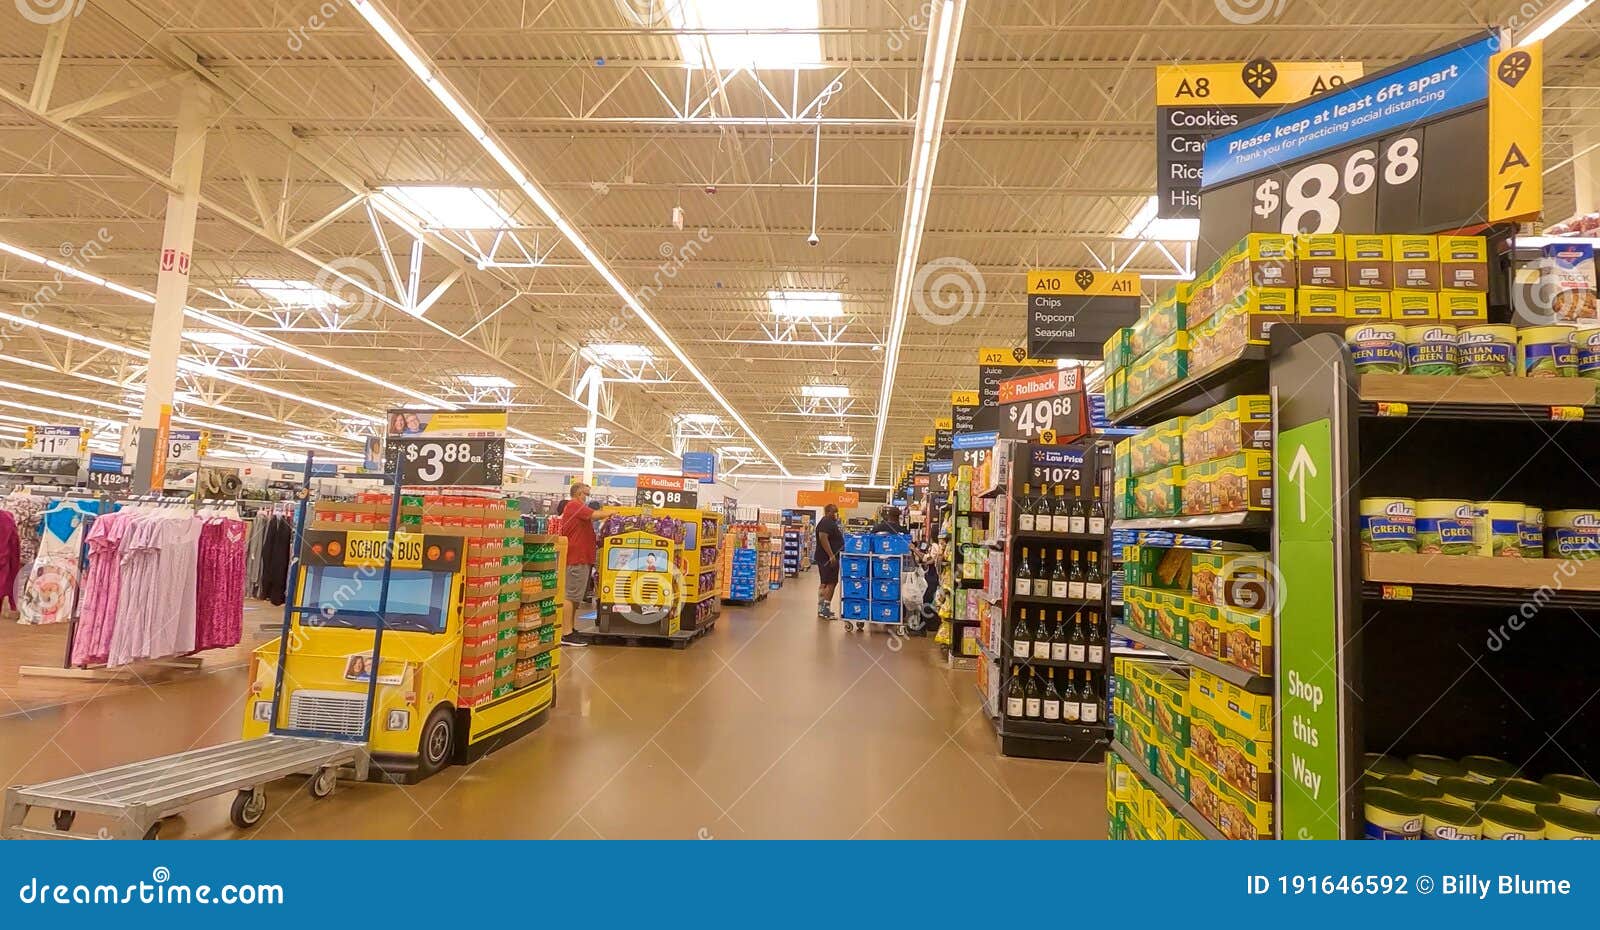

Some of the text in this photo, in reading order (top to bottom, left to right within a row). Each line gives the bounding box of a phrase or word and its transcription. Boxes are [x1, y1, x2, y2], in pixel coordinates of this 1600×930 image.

[1174, 77, 1210, 98] A8
[1229, 64, 1458, 154] Please keep at least 6ft apart
[1171, 110, 1239, 127] Cookies
[1235, 89, 1445, 165] Thank you for practicing social distancing
[1171, 163, 1204, 179] Rice
[1035, 278, 1061, 290] A10
[1111, 279, 1132, 292] A11
[1035, 297, 1062, 308] Chips
[1035, 312, 1075, 324] Popcorn
[1035, 327, 1076, 338] Seasonal
[985, 354, 1002, 363] A12
[1412, 353, 1443, 362] GREEN
[1474, 354, 1505, 363] BEANS
[1015, 378, 1055, 395] Rollback
[1046, 454, 1084, 464] Low Price
[651, 479, 681, 488] Rollback
[1372, 525, 1405, 534] GREEN
[1442, 528, 1472, 537] GREEN
[1560, 535, 1596, 545] GREEN
[349, 539, 421, 560] SCHOO BUS
[1288, 669, 1324, 713] Shop
[1292, 714, 1319, 748] this
[1291, 752, 1322, 801] Way
